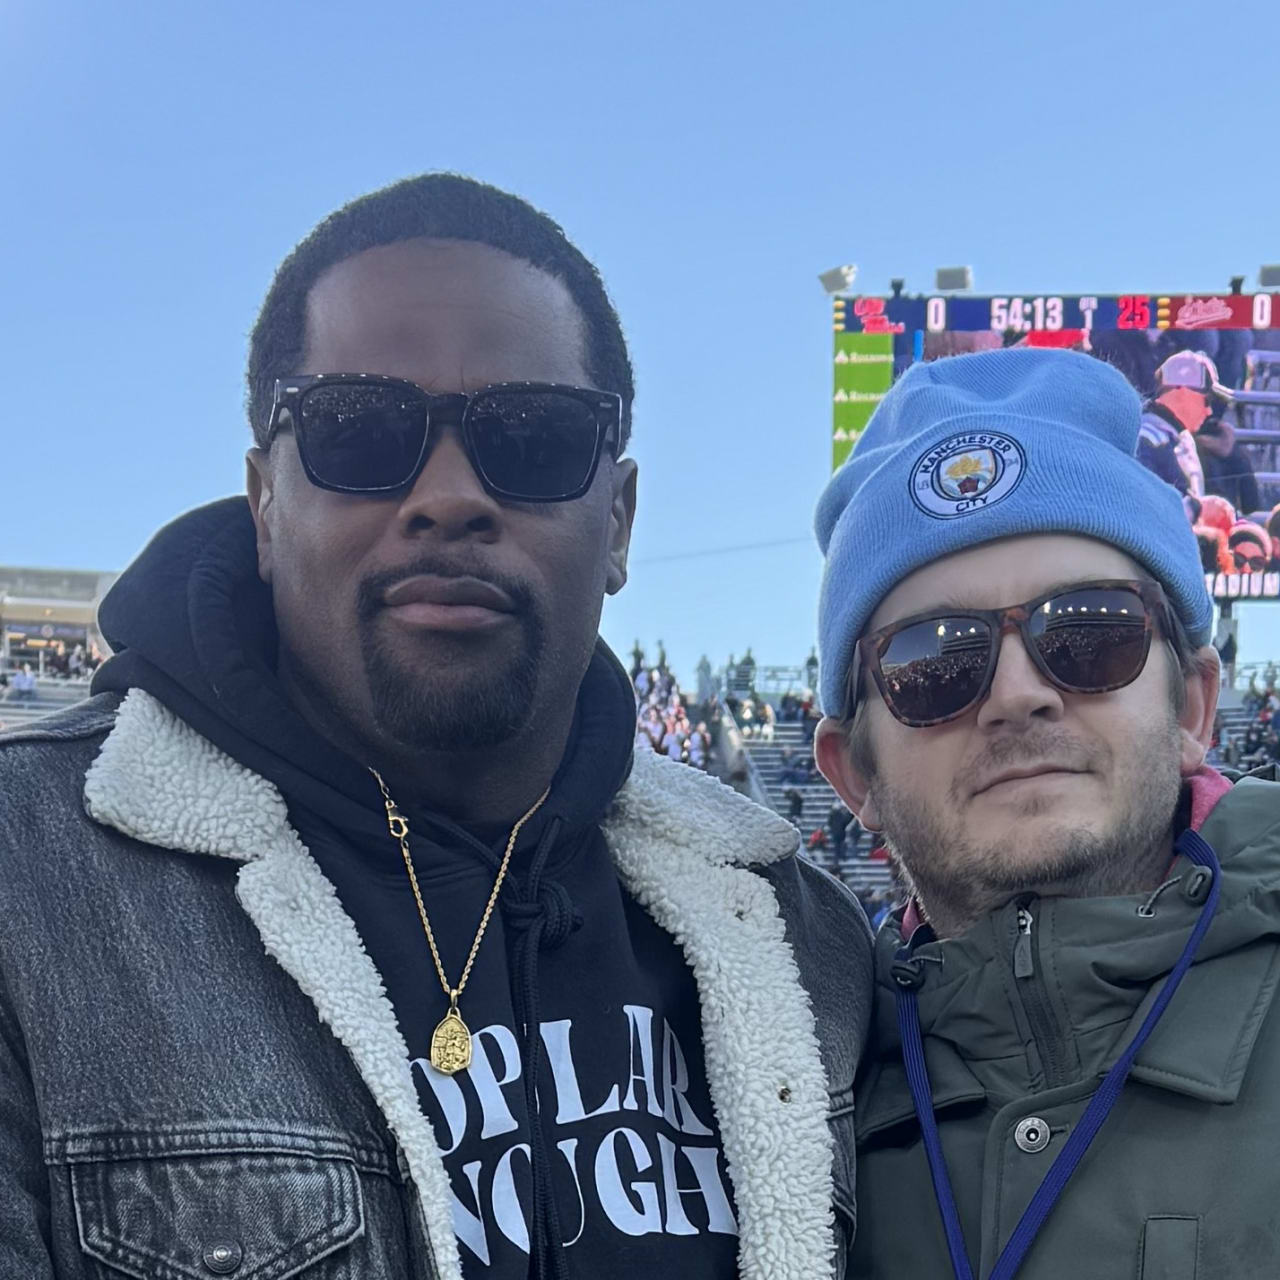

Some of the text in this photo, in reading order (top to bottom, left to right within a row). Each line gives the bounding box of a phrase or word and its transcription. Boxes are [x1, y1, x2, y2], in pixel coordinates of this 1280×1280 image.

[990, 296, 1063, 332] 54:13
[1117, 295, 1150, 329] 25
[1253, 293, 1272, 329] 0
[920, 435, 1012, 473] MANCHESTER
[956, 496, 989, 512] CITY
